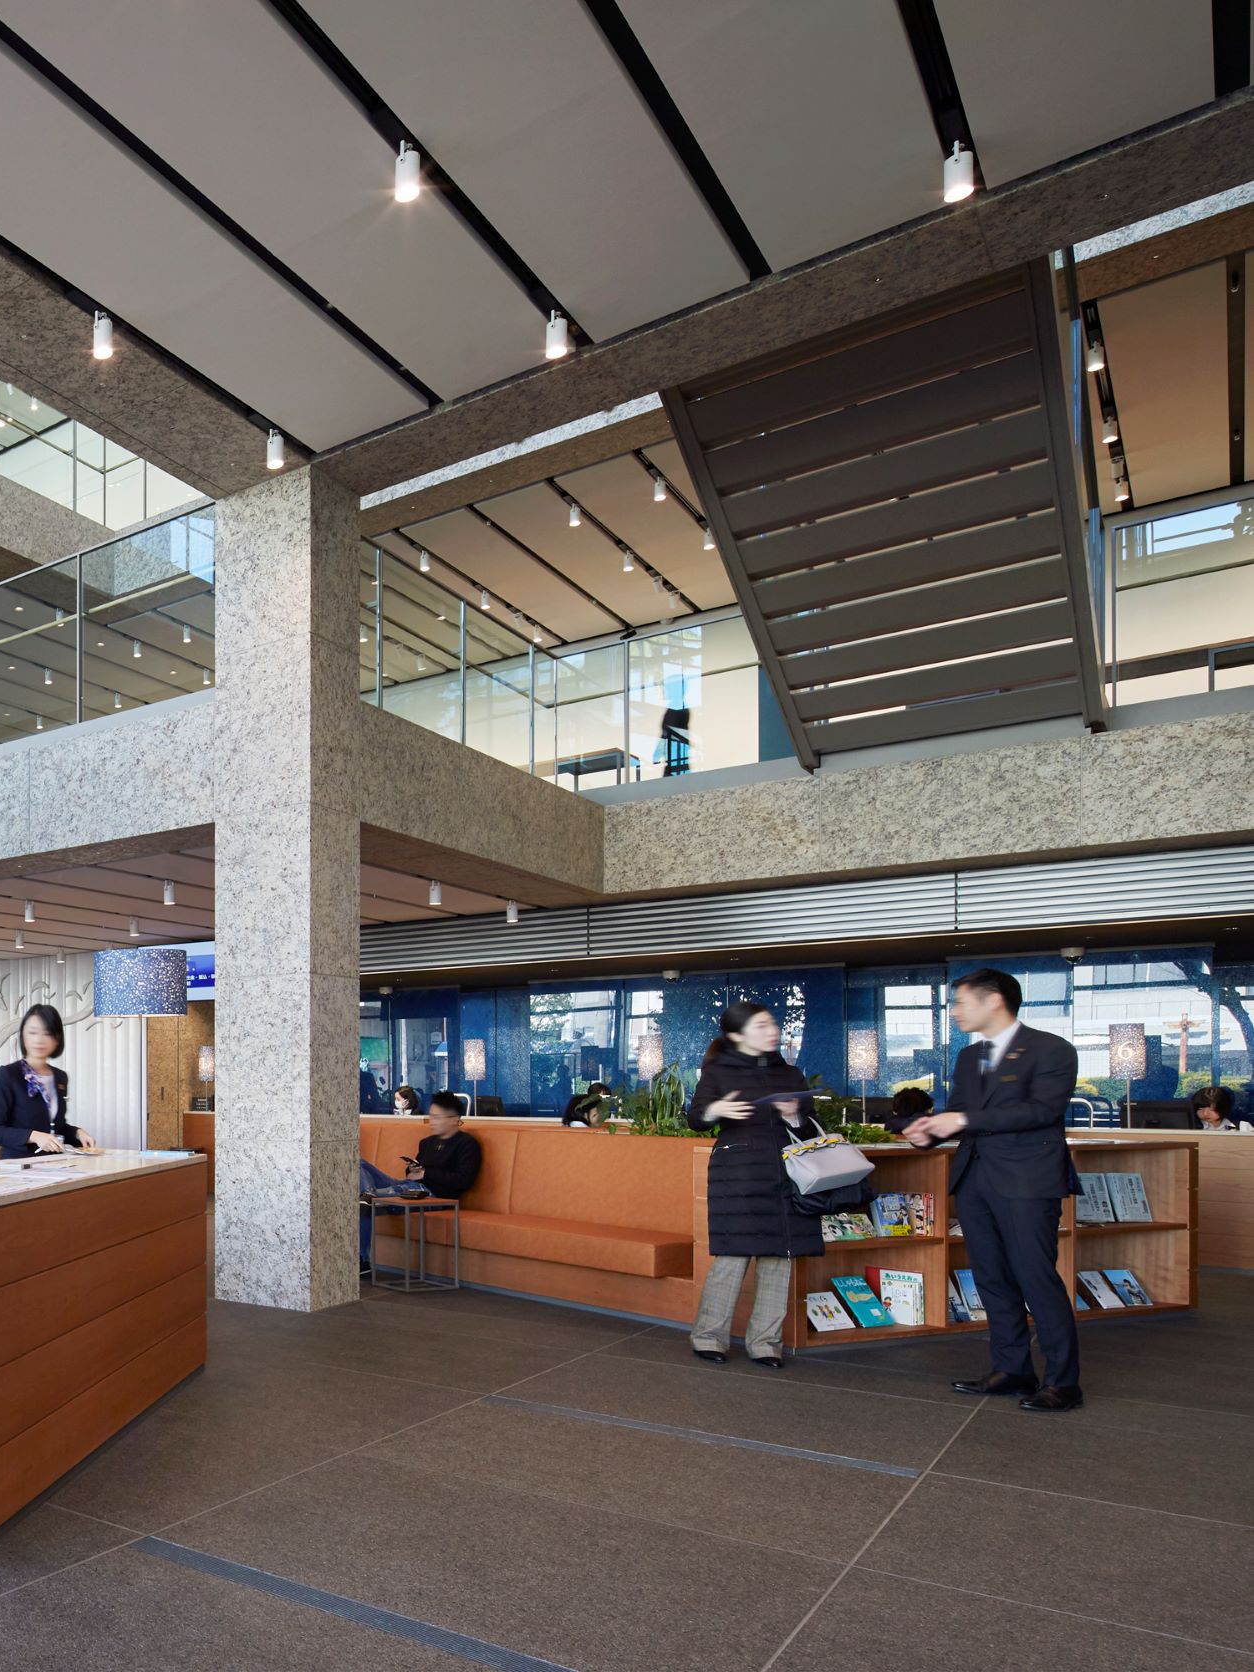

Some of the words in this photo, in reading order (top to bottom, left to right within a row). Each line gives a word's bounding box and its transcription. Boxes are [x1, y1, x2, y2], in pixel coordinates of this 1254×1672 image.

[640, 1050, 652, 1066] 4
[855, 1045, 867, 1062] 5
[1118, 1041, 1133, 1060] 6
[467, 1051, 476, 1067] 3
